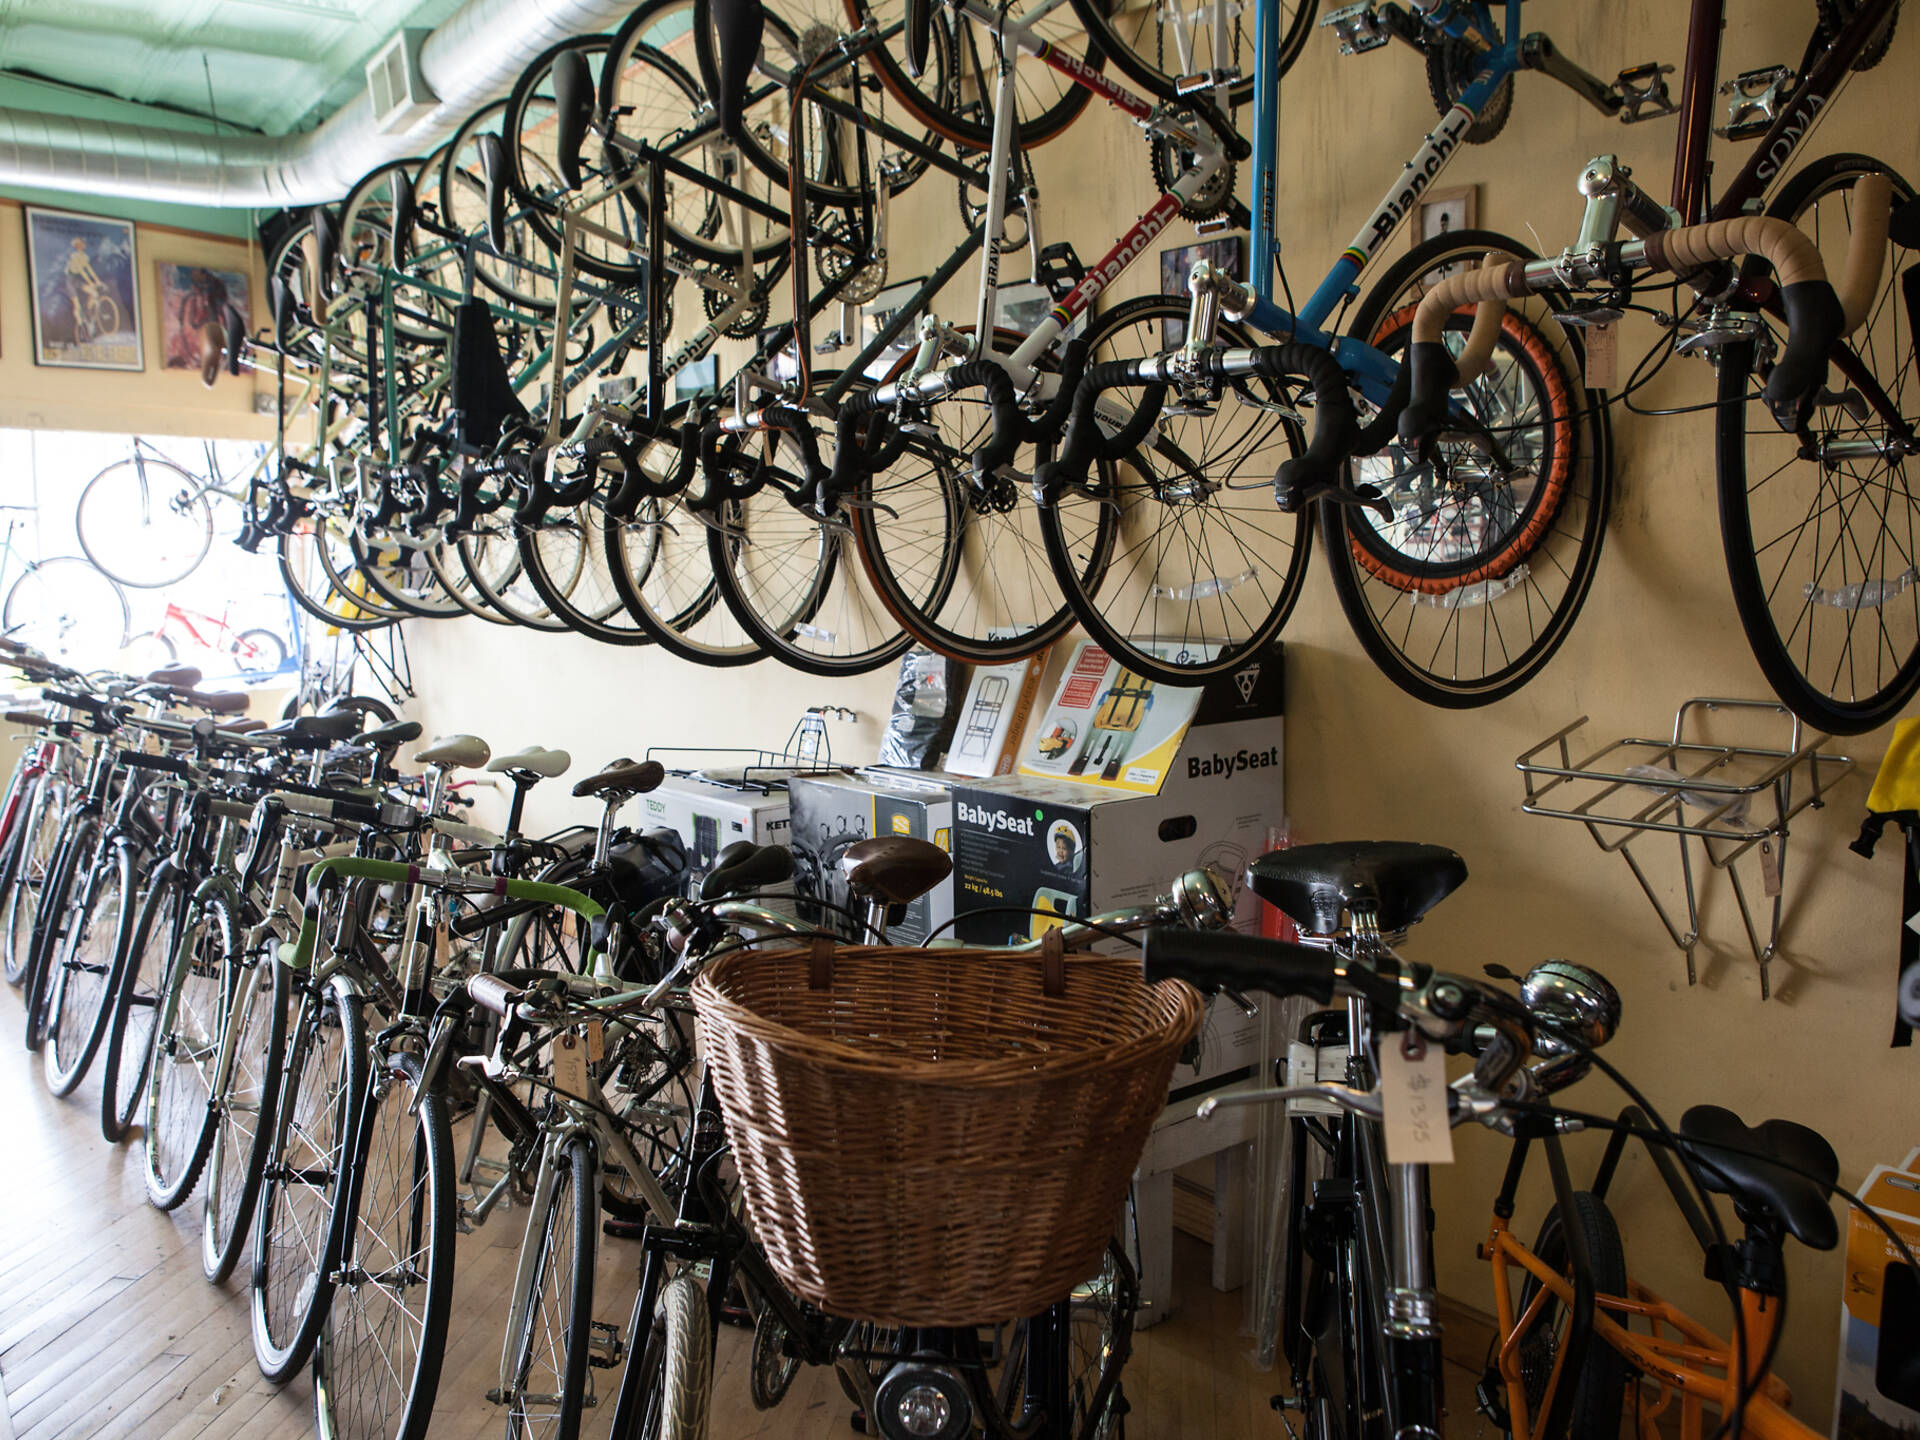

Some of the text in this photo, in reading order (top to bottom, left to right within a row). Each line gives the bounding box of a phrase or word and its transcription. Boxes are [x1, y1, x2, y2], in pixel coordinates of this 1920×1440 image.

[1056, 51, 1147, 110] Bianchi
[1756, 94, 1826, 179] SOMA
[1367, 118, 1467, 252] Bianchi
[987, 237, 1001, 288] BRAVA
[1071, 204, 1176, 311] Bianchi
[631, 333, 711, 406] Bnchi
[1187, 746, 1278, 780] BabySeat
[766, 819, 790, 831] KET
[957, 802, 1034, 836] BabySeat
